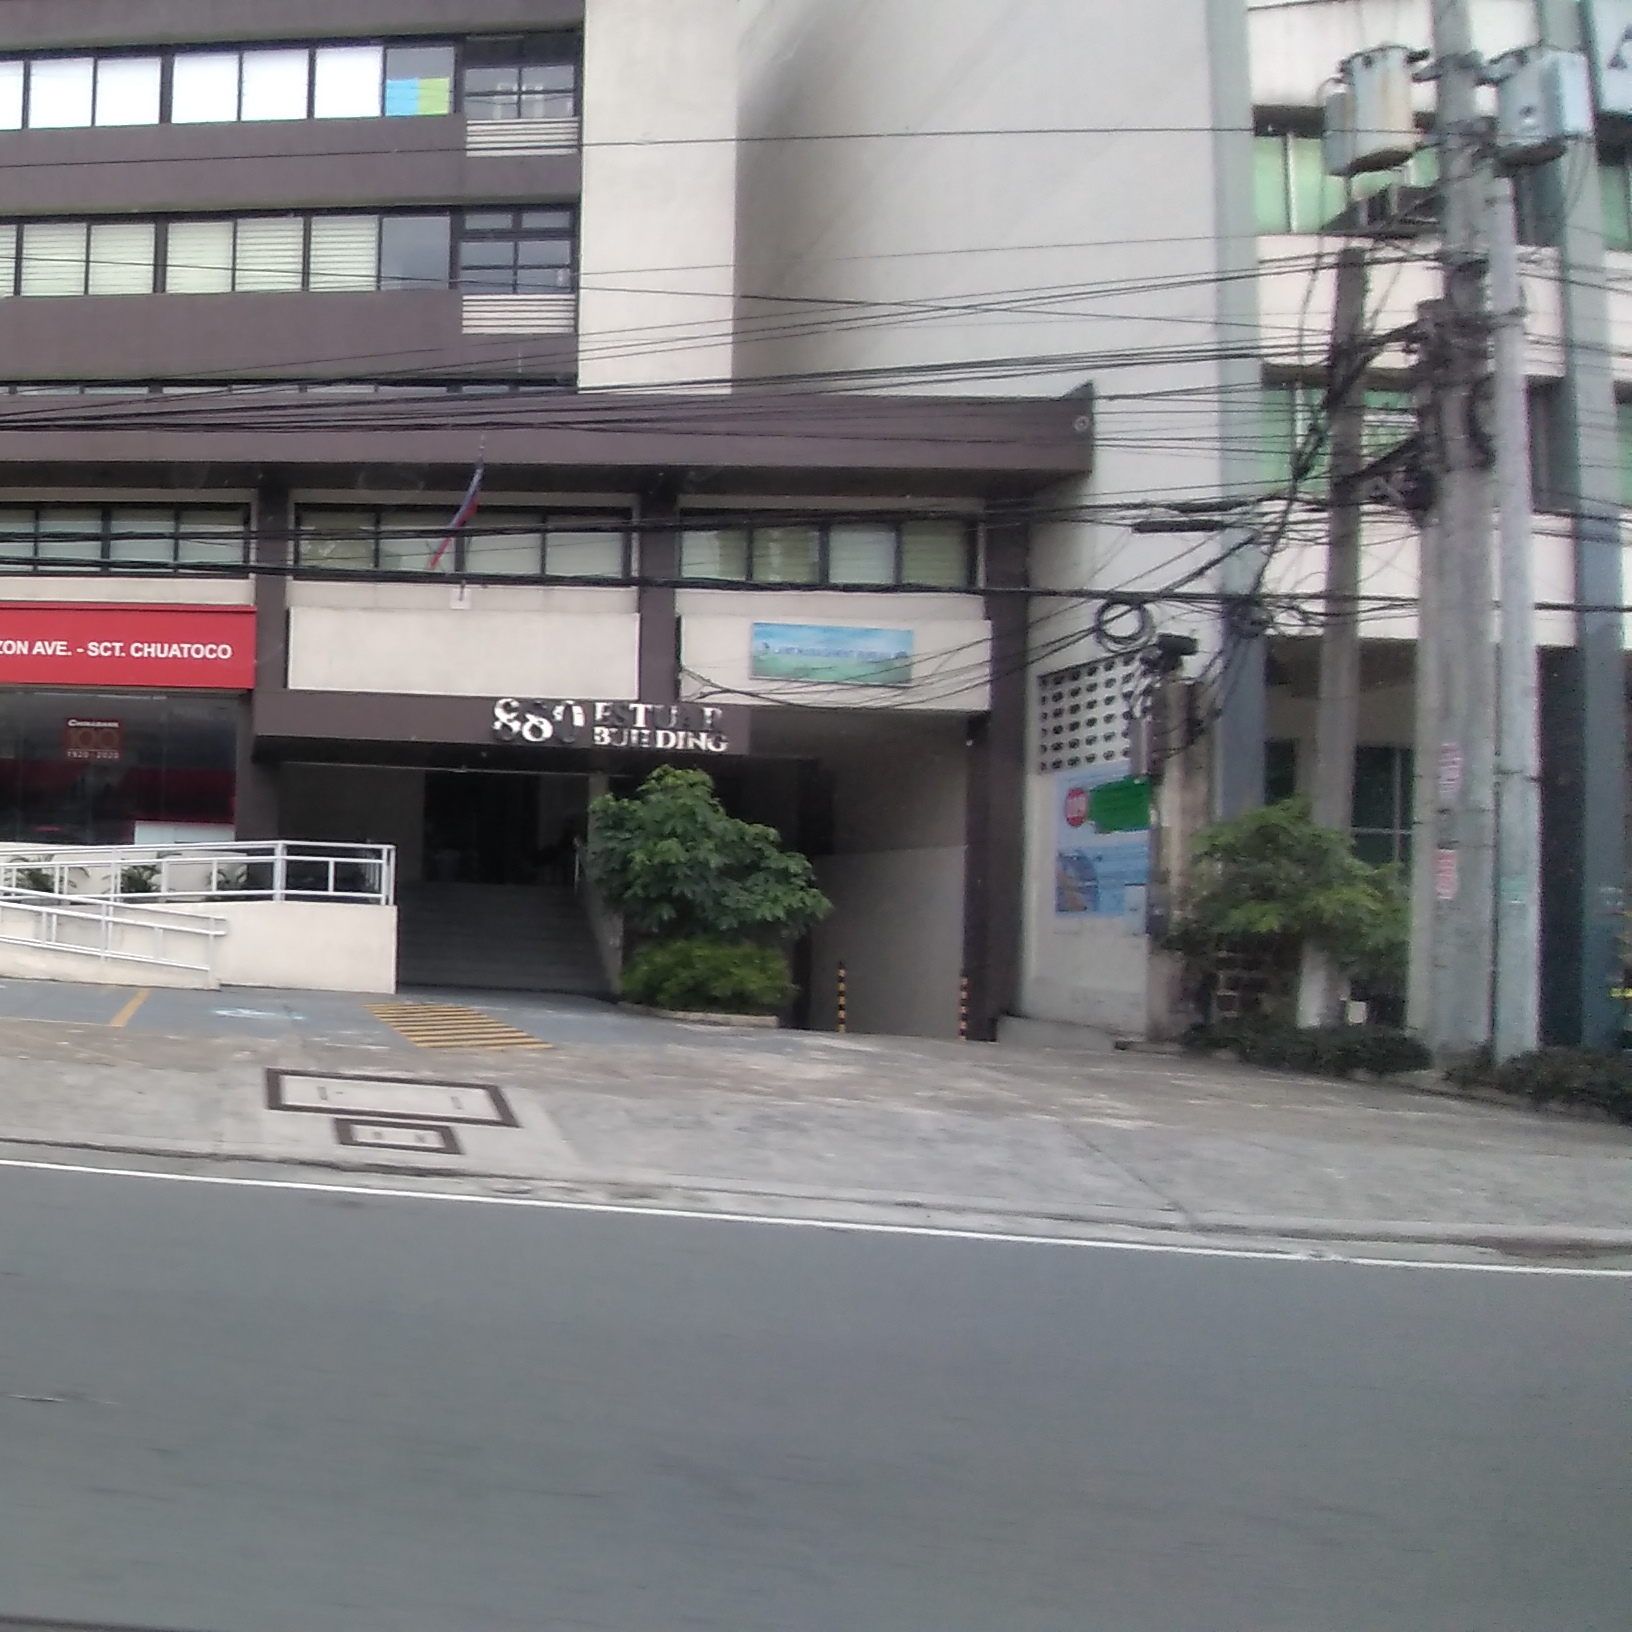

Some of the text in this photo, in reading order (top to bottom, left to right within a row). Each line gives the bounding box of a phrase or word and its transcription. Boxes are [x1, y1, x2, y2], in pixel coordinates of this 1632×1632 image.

[32, 641, 72, 656] AVE.
[87, 641, 126, 657] SCT.
[130, 643, 233, 659] CHUATOCO
[594, 701, 723, 731] ESTUR
